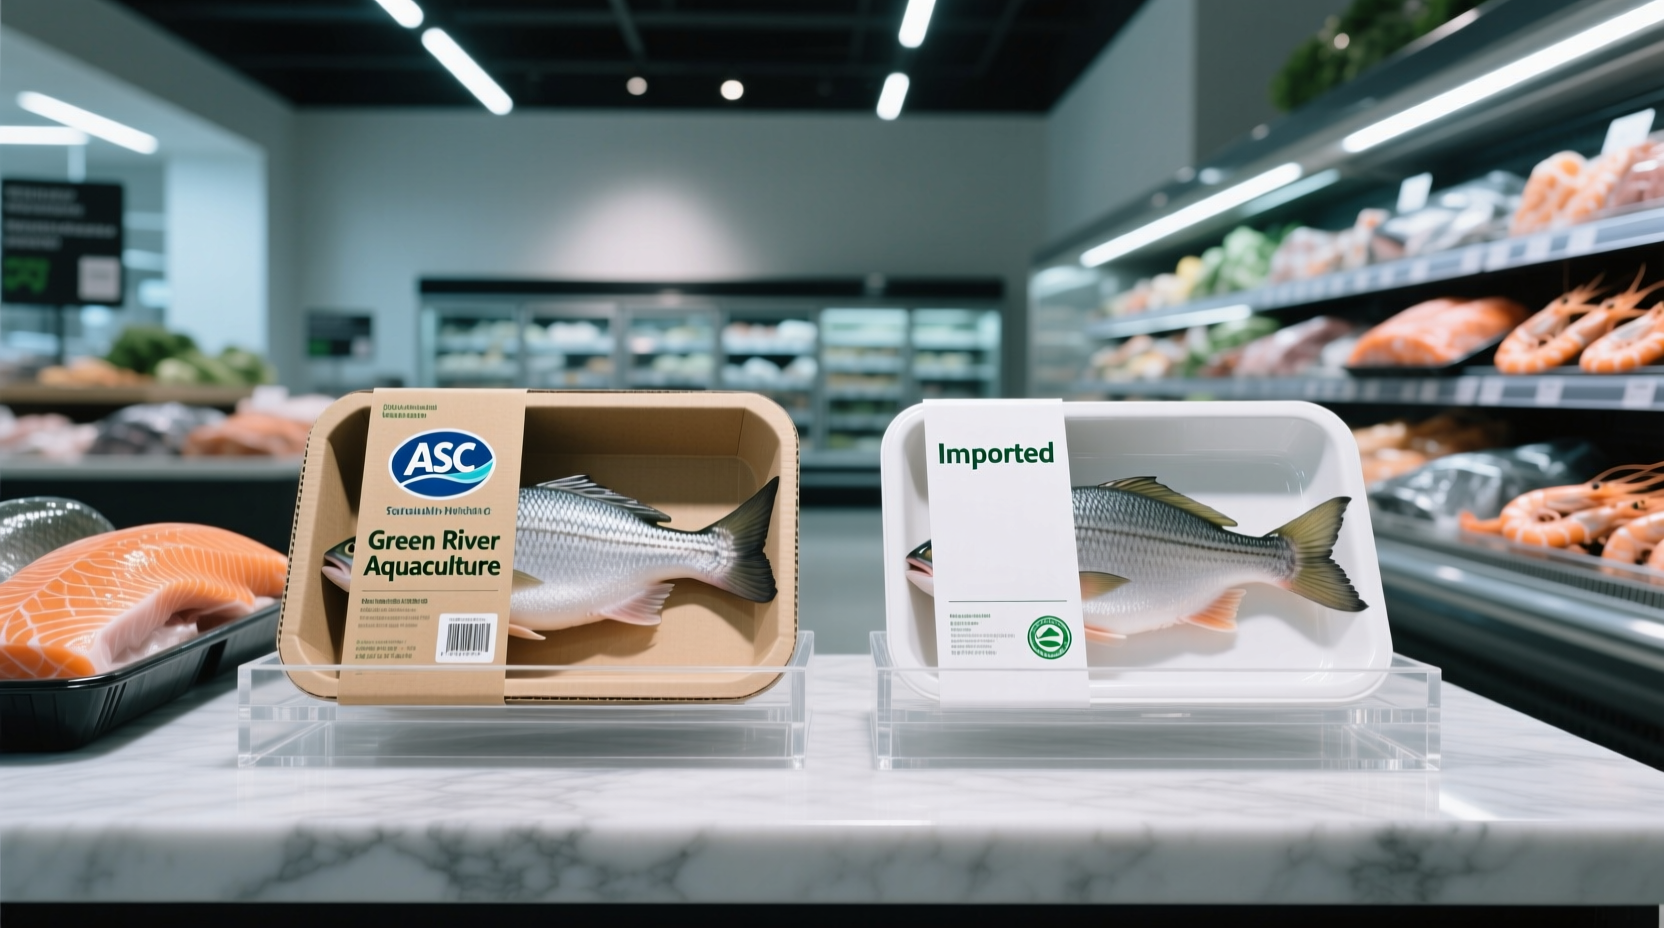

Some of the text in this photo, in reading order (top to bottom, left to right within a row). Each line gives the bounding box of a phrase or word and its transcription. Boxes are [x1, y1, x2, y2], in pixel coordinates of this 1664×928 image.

[403, 441, 476, 475] ASC
[938, 441, 1054, 470] Imported
[368, 529, 501, 550] Green River
[363, 555, 501, 581] Aquaculture
